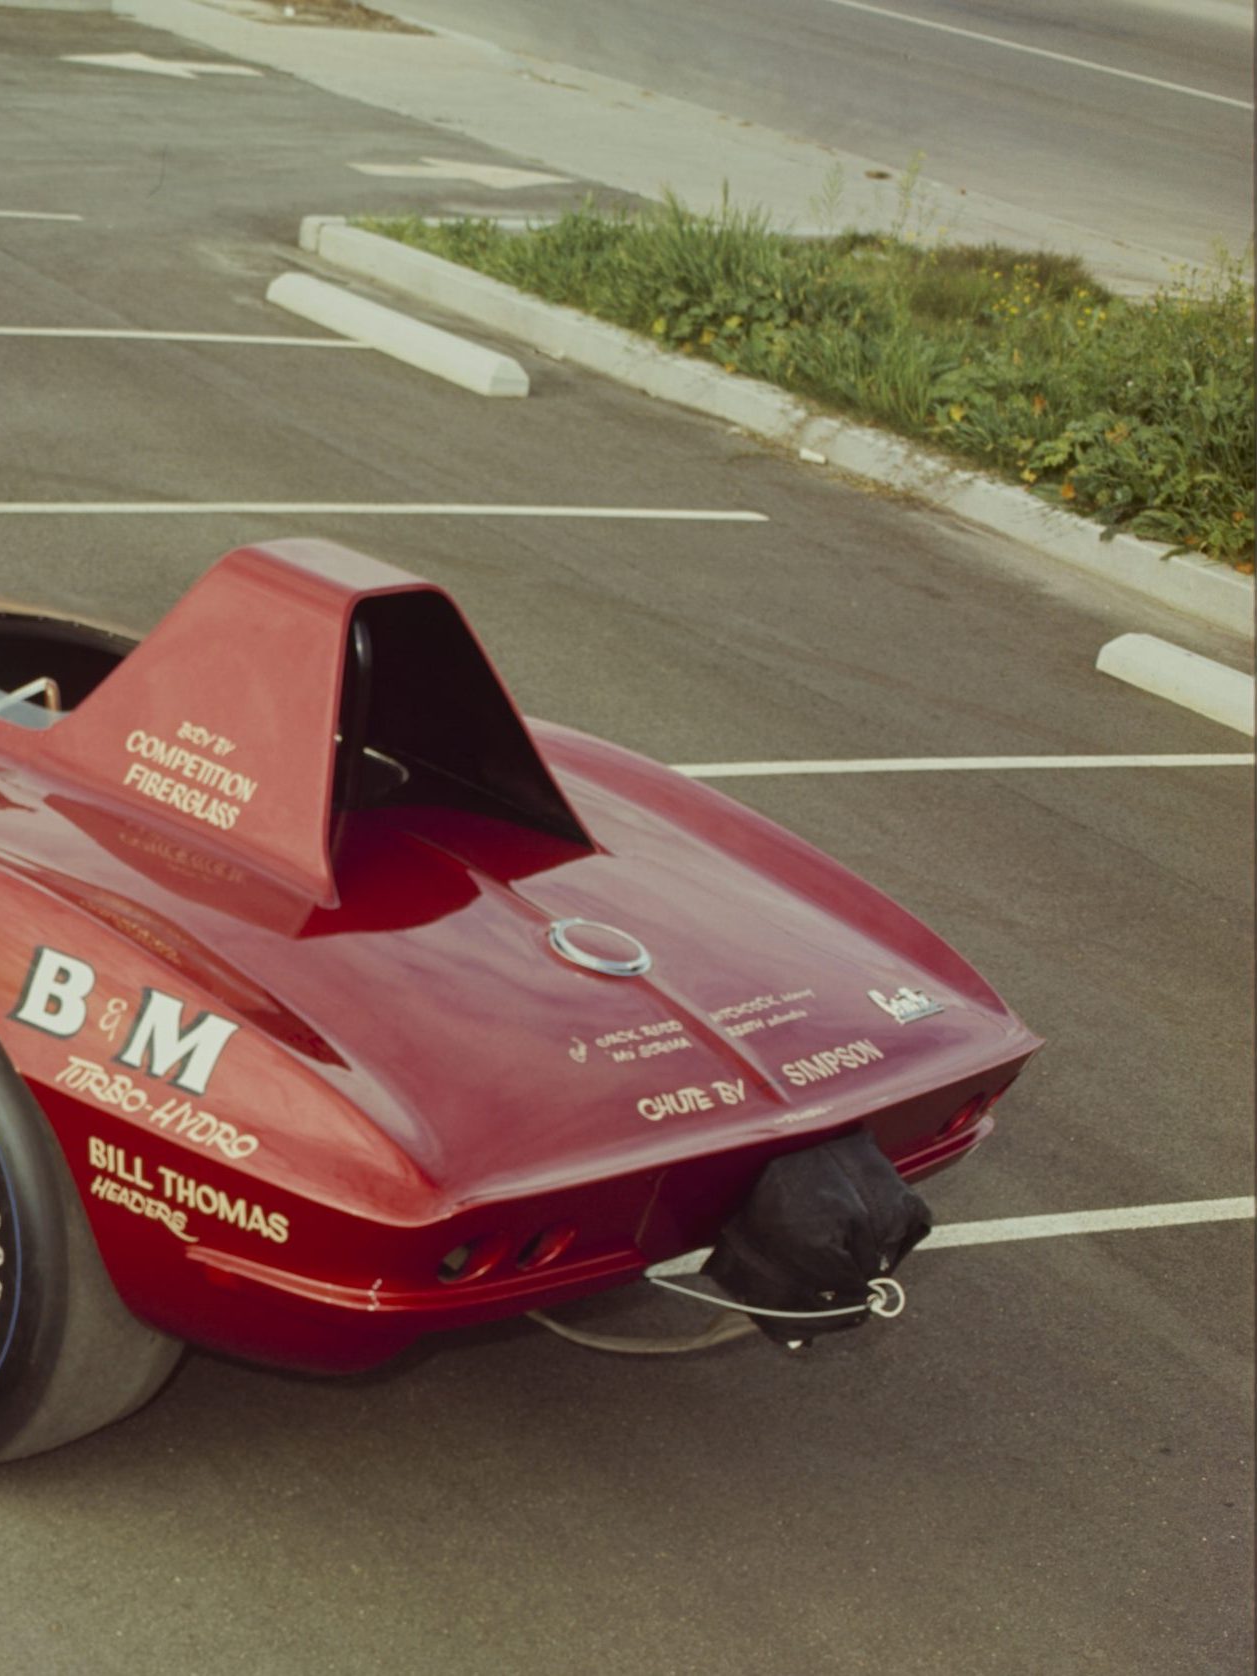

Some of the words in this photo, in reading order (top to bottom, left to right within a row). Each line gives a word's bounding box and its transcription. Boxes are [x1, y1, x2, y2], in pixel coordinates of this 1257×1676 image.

[123, 763, 240, 830] FIBERGLASS
[126, 730, 258, 803] COMPETITION
[781, 1039, 885, 1087] SIMPSON
[55, 1056, 259, 1159] TURBO-HYDRO
[637, 1086, 714, 1121] CHUTE
[711, 1078, 746, 1105] BY
[89, 1136, 154, 1191] BILL
[158, 1166, 289, 1243] THOMAS
[91, 1176, 199, 1243] HEADERS
